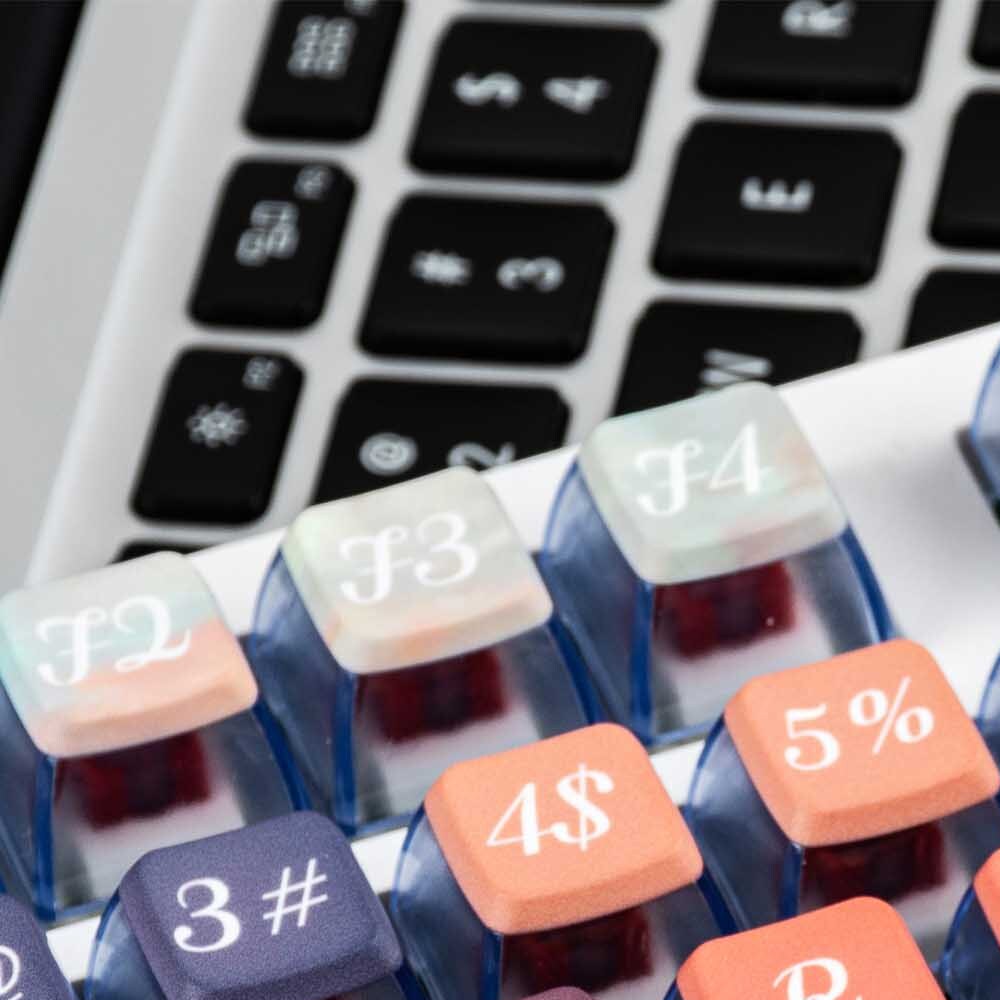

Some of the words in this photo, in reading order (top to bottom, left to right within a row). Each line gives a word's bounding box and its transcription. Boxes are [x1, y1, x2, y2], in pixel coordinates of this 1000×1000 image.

[544, 76, 608, 113] 4
[741, 177, 813, 210] E
[498, 257, 564, 291] 3
[635, 422, 774, 517] F4
[339, 511, 479, 604] F3
[36, 594, 192, 686] F2
[485, 763, 614, 856] 4$
[173, 877, 241, 952] 3
